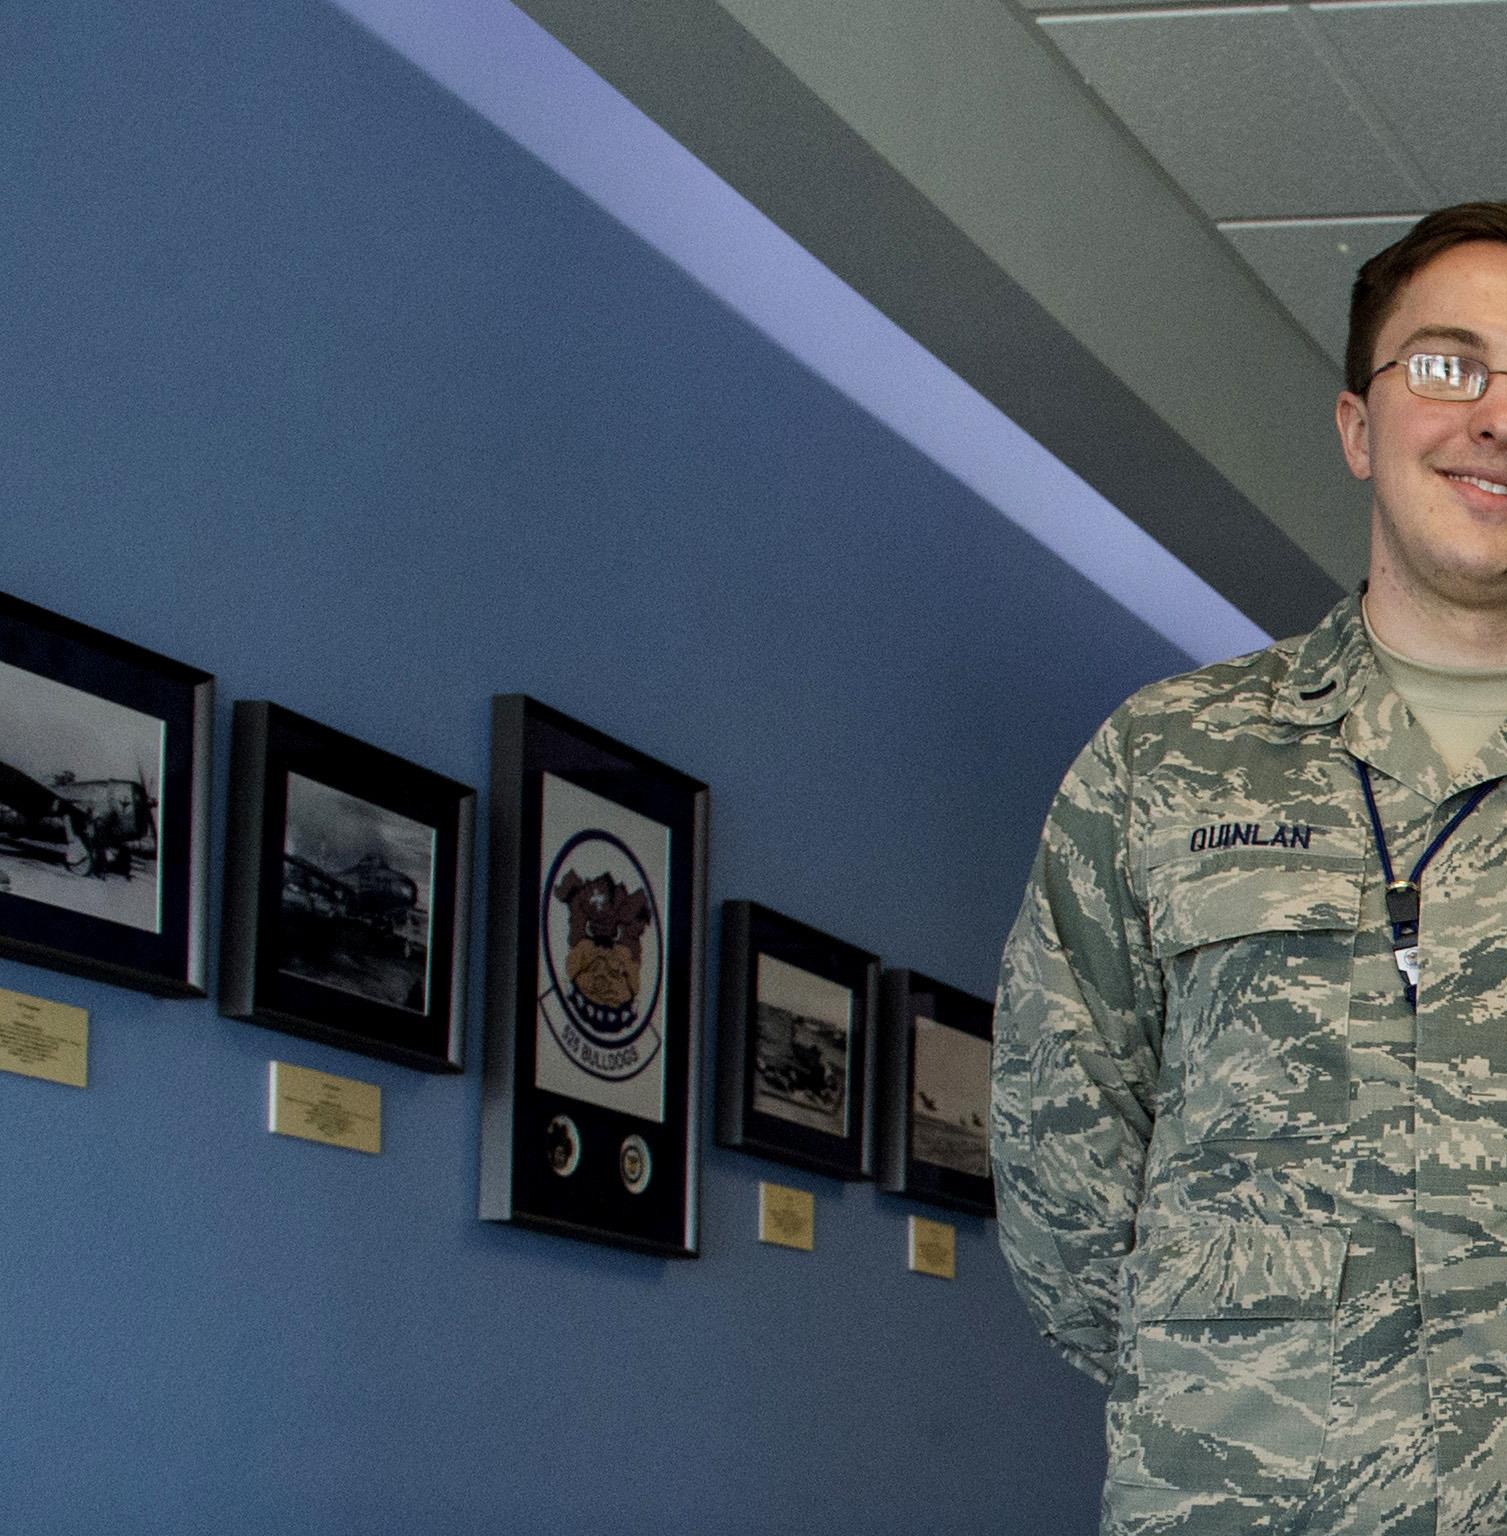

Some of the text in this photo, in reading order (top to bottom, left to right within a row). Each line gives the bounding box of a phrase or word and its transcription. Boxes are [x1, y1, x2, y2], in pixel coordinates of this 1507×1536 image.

[1190, 822, 1313, 852] QUINLAN
[561, 1023, 639, 1071] 525 BULLDOGS
